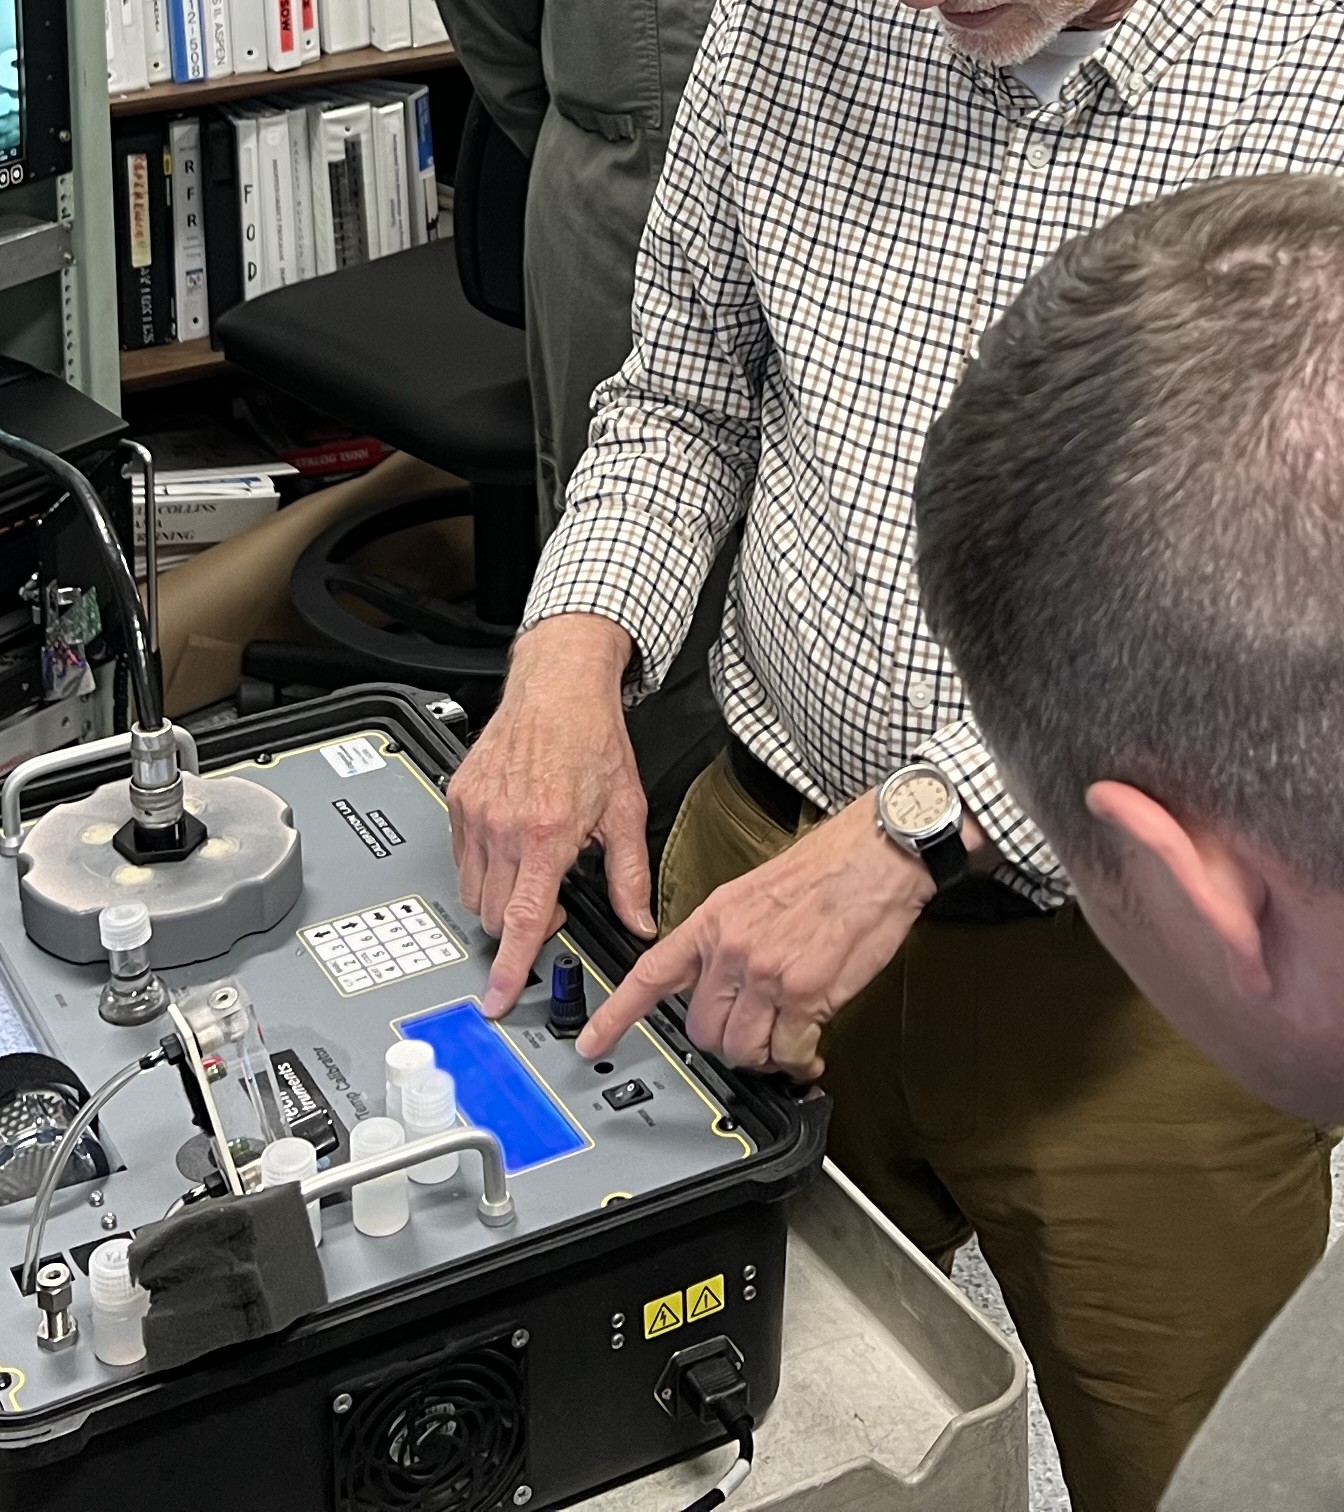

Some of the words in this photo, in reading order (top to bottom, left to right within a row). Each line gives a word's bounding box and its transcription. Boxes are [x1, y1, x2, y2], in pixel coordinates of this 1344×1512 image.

[280, 0, 291, 31] SOW
[214, 19, 227, 66] ASPEN
[184, 159, 198, 228] RFR
[243, 184, 257, 282] FOD
[157, 503, 217, 515] COLLINS
[278, 1062, 316, 1111] truments
